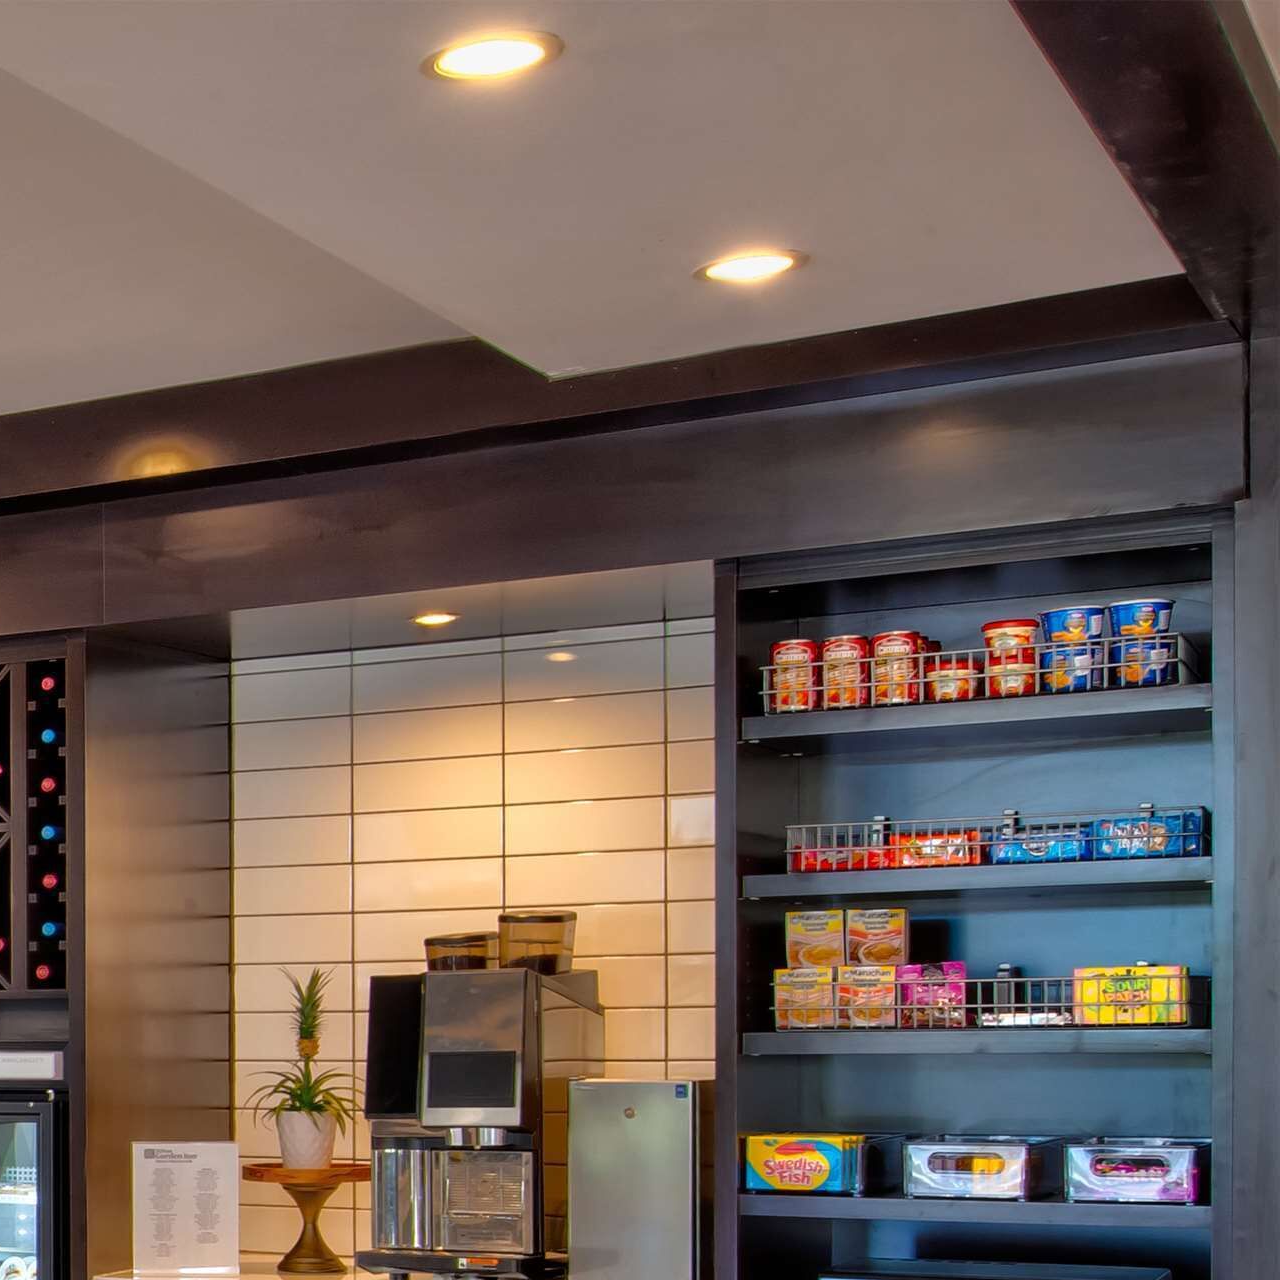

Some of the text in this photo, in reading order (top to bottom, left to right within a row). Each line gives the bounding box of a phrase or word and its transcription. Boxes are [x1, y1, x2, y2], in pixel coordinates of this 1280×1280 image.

[1104, 978, 1149, 992] SOUR
[1102, 991, 1150, 1002] PATCH
[763, 1157, 825, 1176] Swedish
[776, 1170, 811, 1185] Fish
